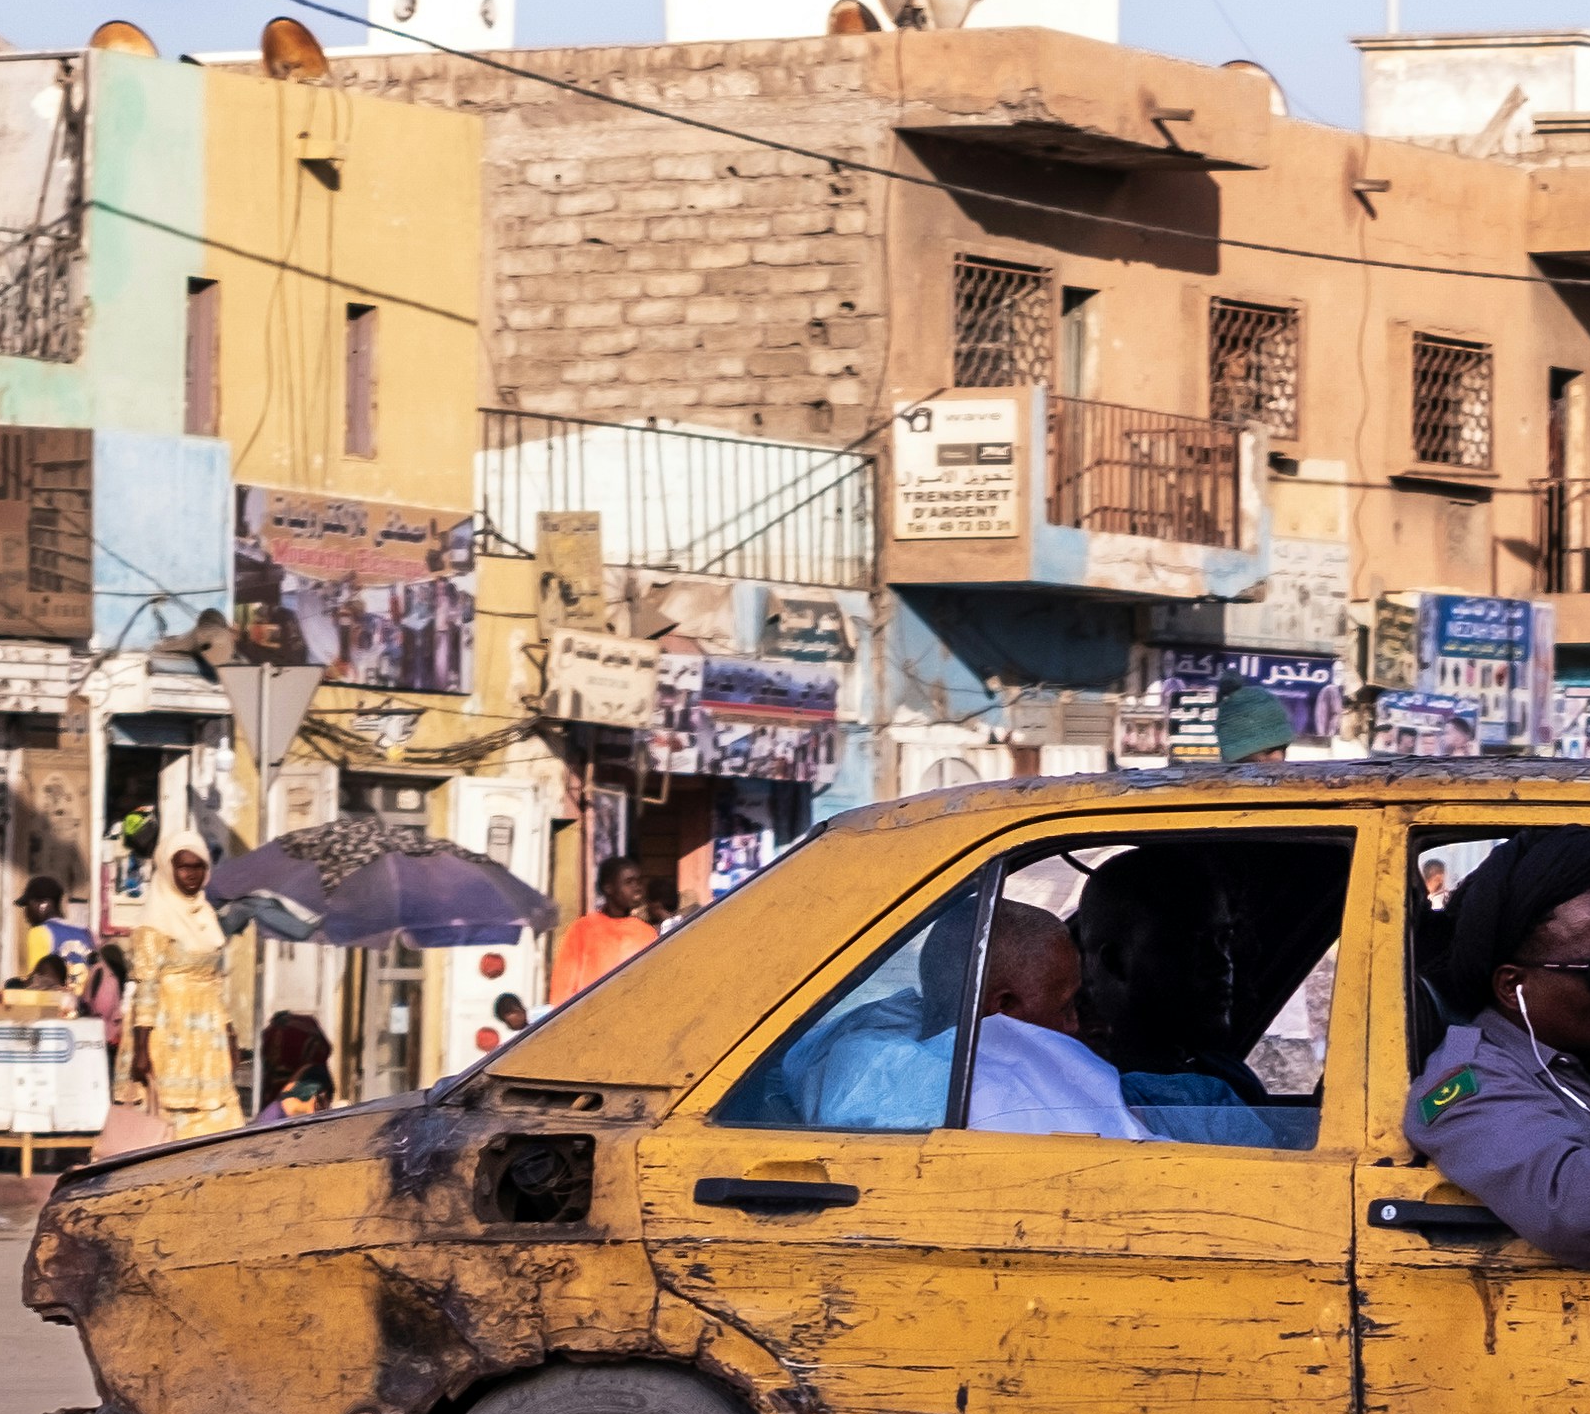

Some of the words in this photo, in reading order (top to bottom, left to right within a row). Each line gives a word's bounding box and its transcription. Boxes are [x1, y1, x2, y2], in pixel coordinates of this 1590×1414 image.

[903, 488, 1012, 504] TRENSFERT
[912, 504, 998, 520] D'ARGENT
[1261, 661, 1331, 686] متجر
